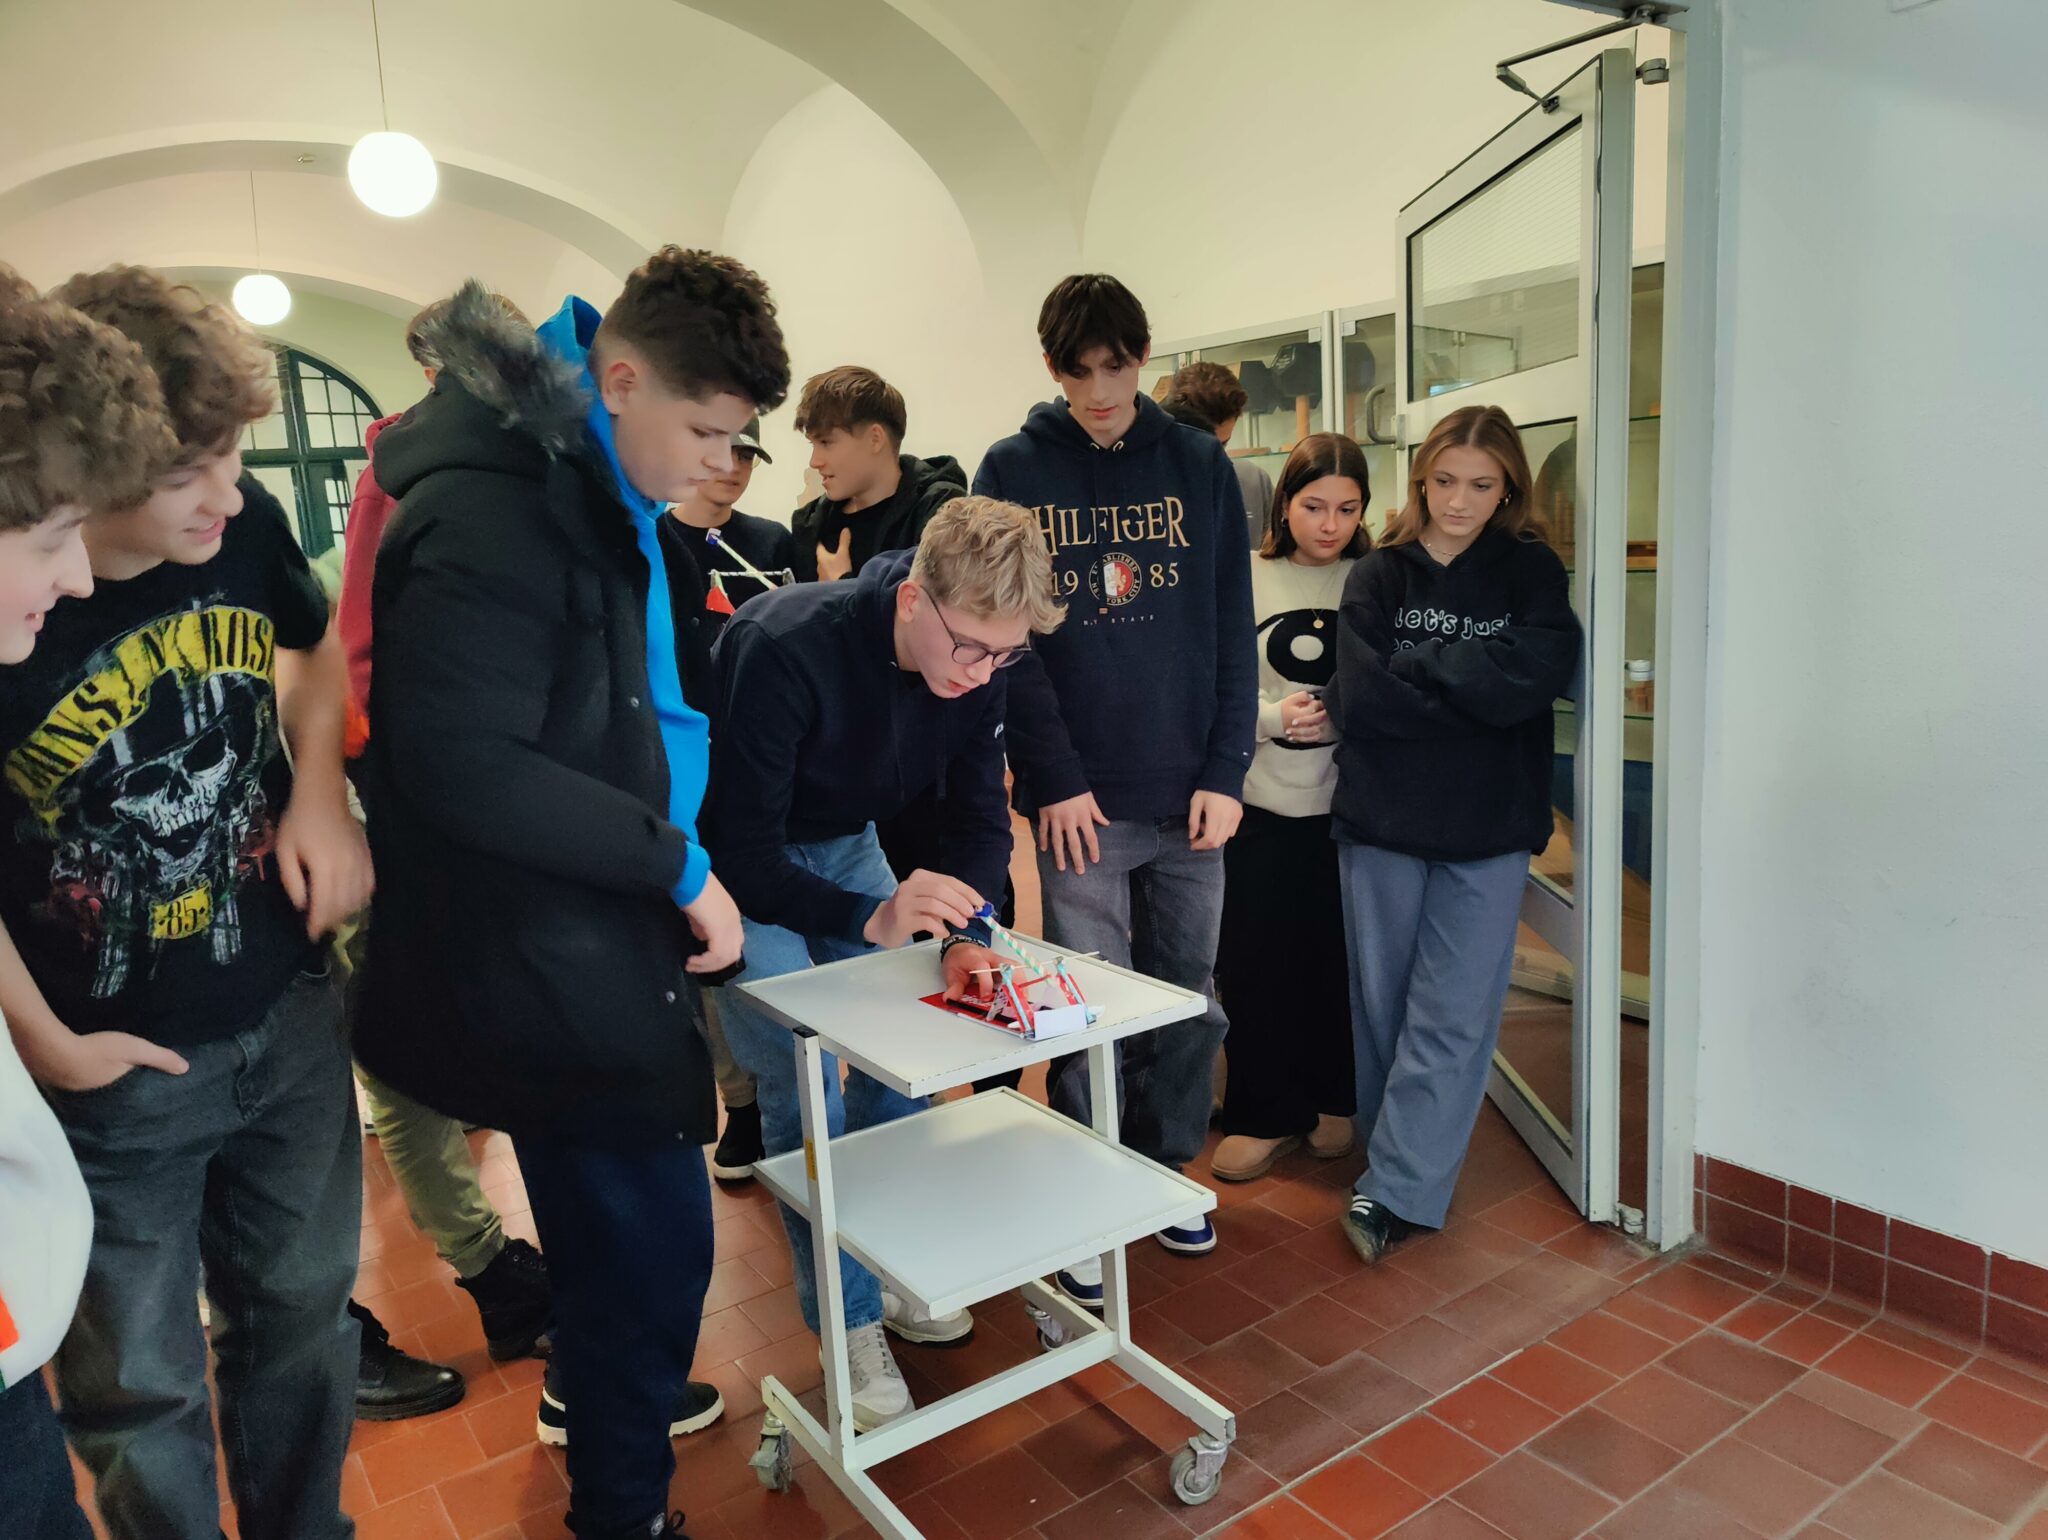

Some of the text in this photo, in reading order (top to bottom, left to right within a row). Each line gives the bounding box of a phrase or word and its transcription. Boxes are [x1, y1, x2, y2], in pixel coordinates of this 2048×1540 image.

[1031, 496, 1191, 556] HILFIGER
[1052, 561, 1179, 596] 19 85
[199, 610, 275, 677] ROS
